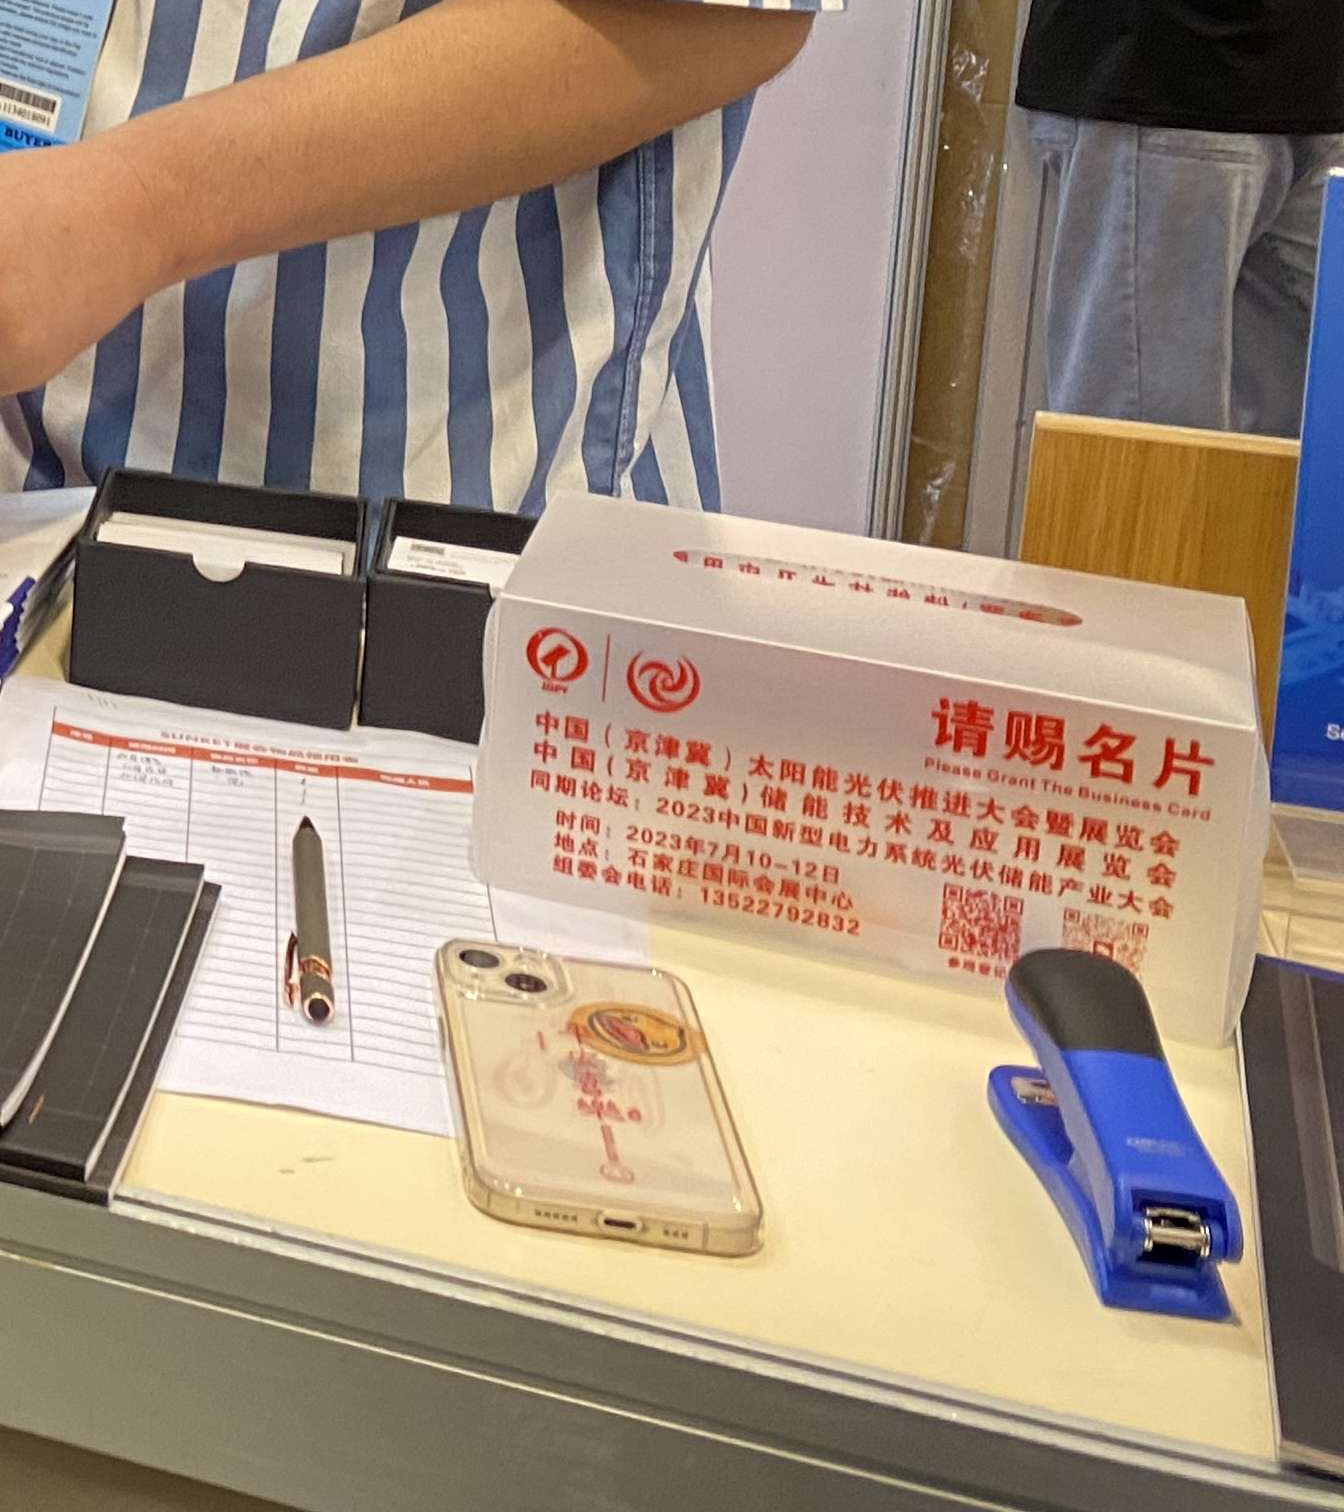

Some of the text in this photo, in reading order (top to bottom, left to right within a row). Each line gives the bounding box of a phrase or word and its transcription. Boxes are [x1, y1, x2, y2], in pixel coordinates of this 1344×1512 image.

[925, 756, 1212, 823] Please Grant The Business Card
[931, 697, 1215, 798] 请赐名片
